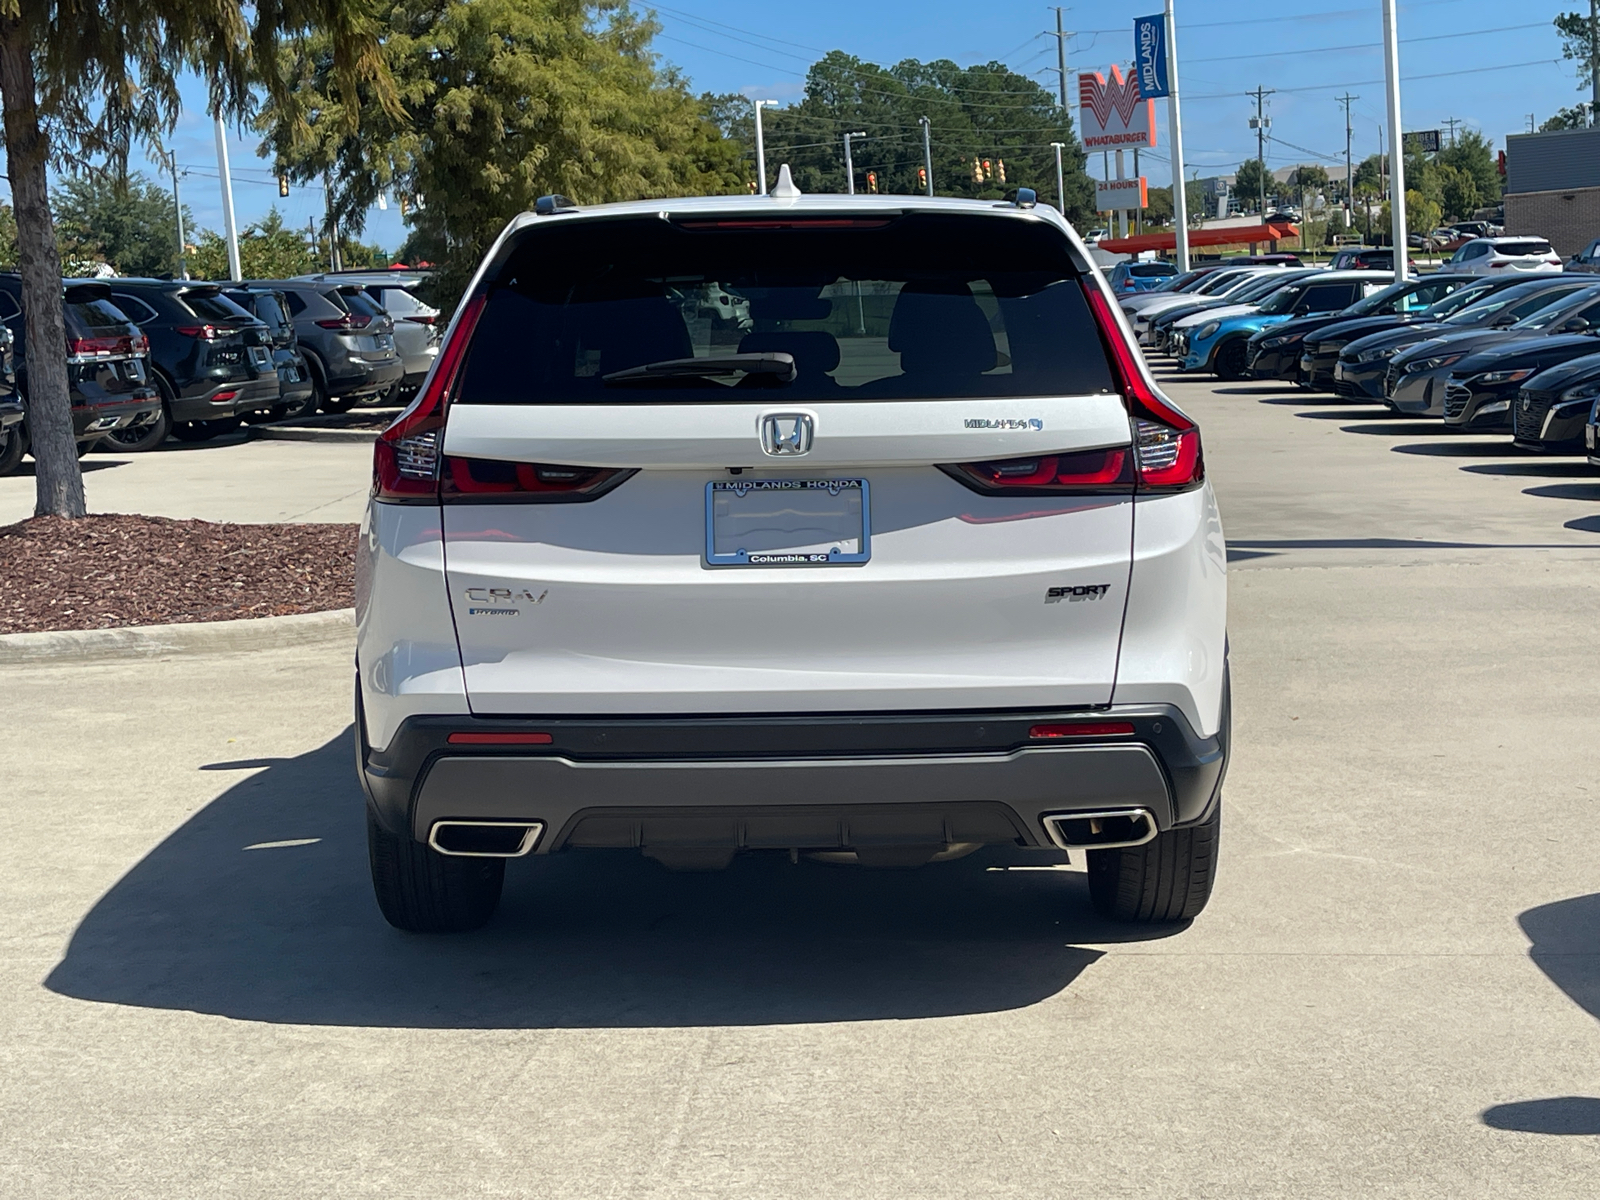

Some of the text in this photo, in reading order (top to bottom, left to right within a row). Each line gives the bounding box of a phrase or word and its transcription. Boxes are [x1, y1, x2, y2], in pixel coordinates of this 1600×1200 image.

[1140, 22, 1155, 91] MIDLANDS
[1085, 132, 1147, 147] WHATABURGER
[1098, 180, 1138, 191] 24 HOURS
[725, 480, 859, 490] MIDLANDS HONDA
[810, 554, 827, 562] SC
[464, 587, 548, 604] CR-V
[1048, 583, 1111, 598] SPORT
[474, 608, 520, 616] HYBRID
